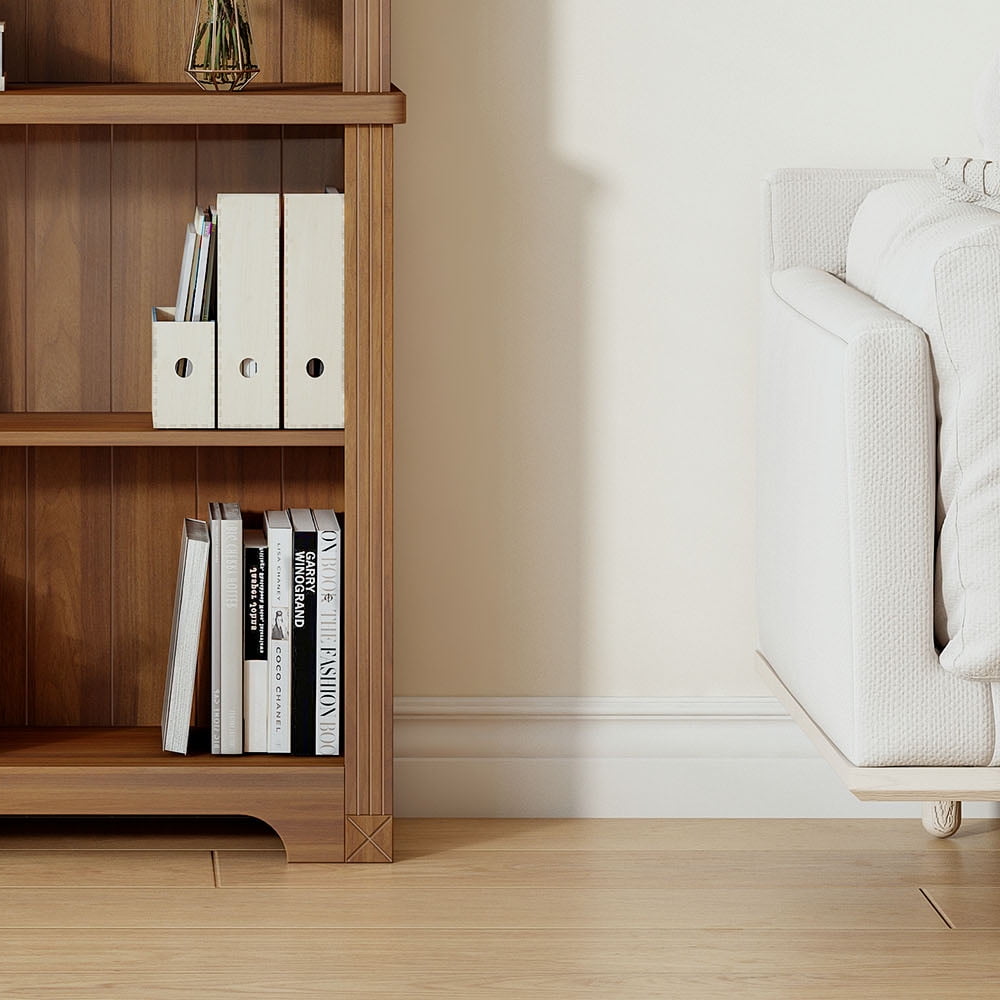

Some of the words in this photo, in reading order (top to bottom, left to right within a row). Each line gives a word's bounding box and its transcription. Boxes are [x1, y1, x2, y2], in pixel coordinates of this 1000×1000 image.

[321, 530, 337, 552] ON
[294, 551, 305, 628] WINOGRAND
[305, 551, 316, 593] GARRY
[320, 609, 337, 644] THE
[320, 647, 337, 717] FASHION
